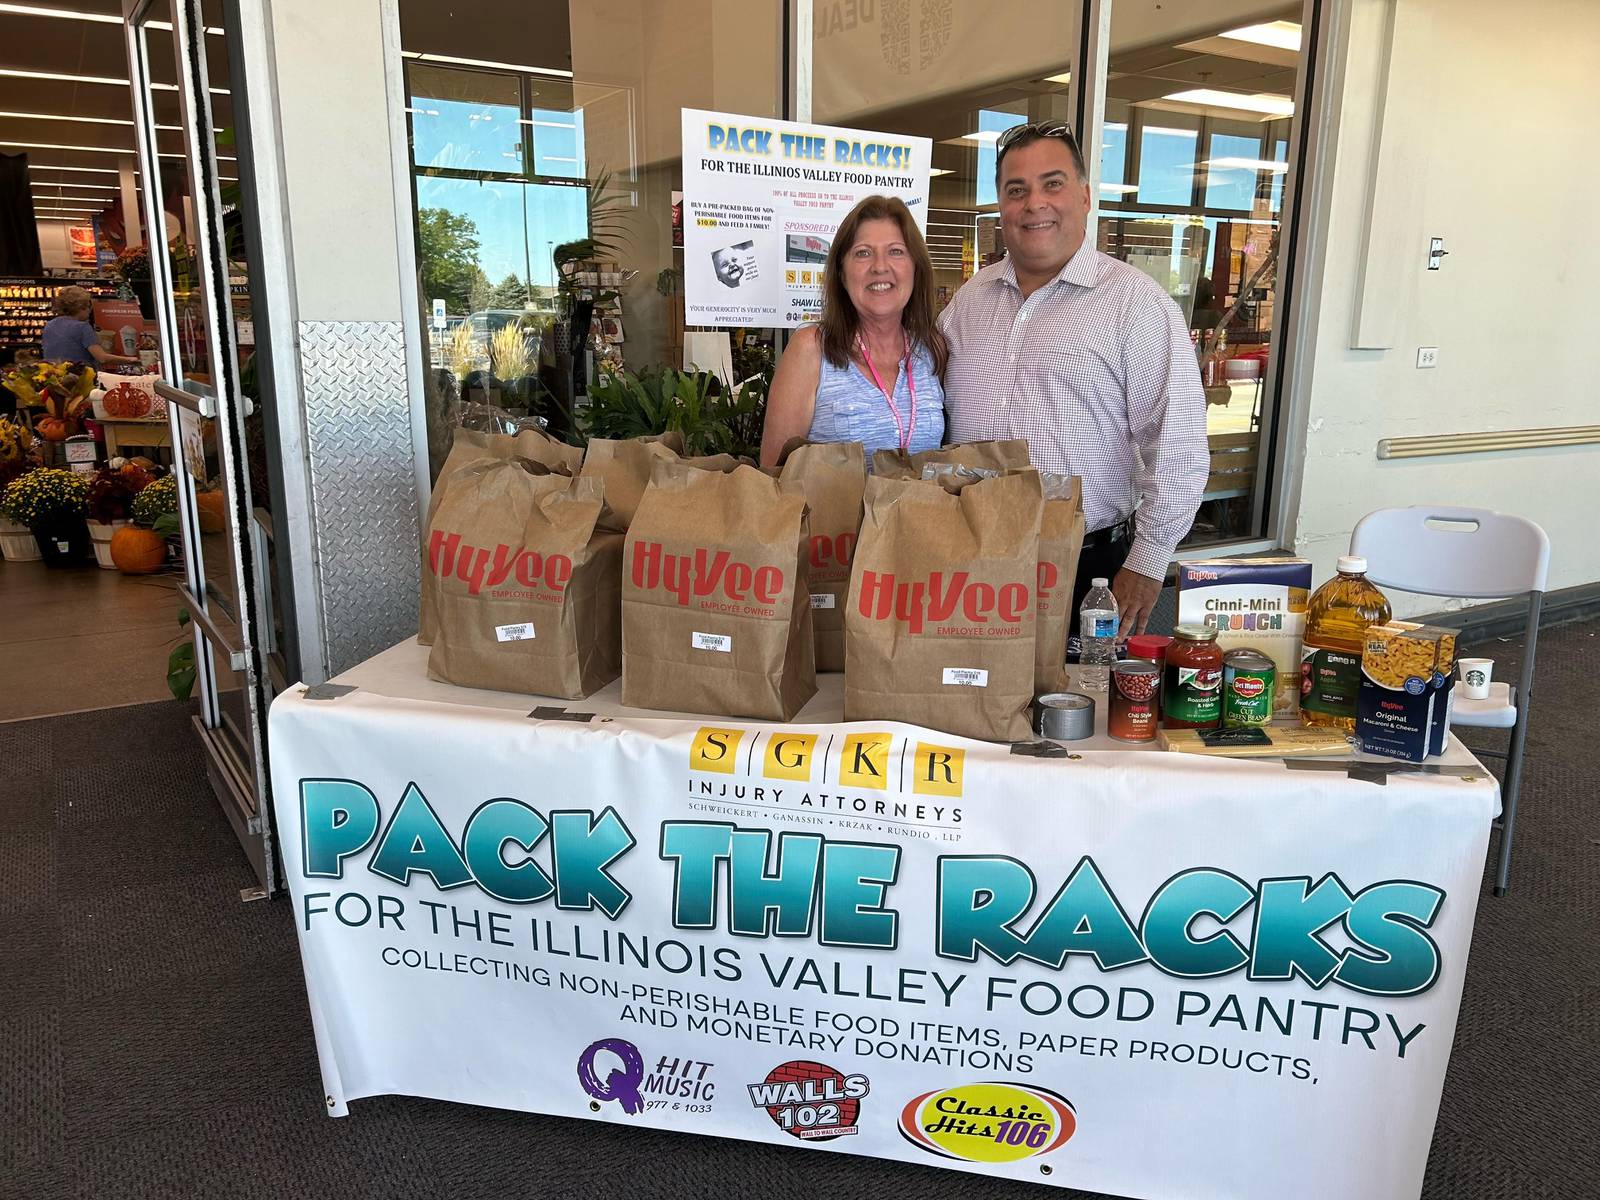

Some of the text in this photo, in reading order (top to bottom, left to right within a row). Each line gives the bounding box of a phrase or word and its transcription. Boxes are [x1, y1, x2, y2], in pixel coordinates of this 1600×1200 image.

[708, 124, 912, 169] PACK THE RACKS!
[700, 158, 914, 188] FOR THE ILLINIOS VALLEY FOOD PANTRY
[694, 211, 727, 219] PERISHABLE
[708, 203, 741, 211] PRE-PACKED
[784, 221, 829, 232] SPONSORED
[791, 298, 813, 307] SHAW
[428, 529, 572, 596] HyVee
[631, 540, 784, 606] HyVee
[1188, 570, 1218, 582] HyVee
[491, 590, 564, 604] EMPLOYEE OWNED
[700, 601, 775, 617] EMPLOYEE OWNED
[858, 569, 1029, 634] HyVee
[1205, 598, 1280, 611] Cinni-Mini
[937, 626, 1021, 636] EMPLOYEE OWNED
[1204, 612, 1282, 632] CRUNCH
[1244, 682, 1263, 690] Monte
[1228, 711, 1247, 721] GREEN
[1240, 706, 1254, 715] CUT
[1375, 711, 1407, 723] Original
[1363, 717, 1389, 728] Macaroni
[1395, 723, 1419, 733] Cheese
[701, 732, 958, 784] S G K R
[688, 779, 963, 823] INJURY ATTORNEYS
[688, 802, 962, 842] SCHWEICKERT GANASSIN KRZAK RUNDIO LLP
[299, 777, 1447, 998] PACK THE RACKS
[303, 891, 1427, 1059] FOR THE ILLINOIS VALLEY FOOD PANTRY
[381, 946, 1320, 1085] COLLECTING NON-PERISHABLE FOOD ITEMS, PAPER PRODUCTS,
[619, 1004, 1034, 1074] AND MONETARY DONATIONS
[577, 1038, 715, 1117] Q HIT
[644, 1073, 716, 1102] MUSIC
[747, 1073, 871, 1109] WALLS
[645, 1100, 713, 1114] 977 & 1033
[778, 1102, 842, 1131] 102
[935, 1096, 1046, 1122] Classic
[833, 1127, 856, 1135] COUNTRY
[924, 1115, 1052, 1149] Hits 106
